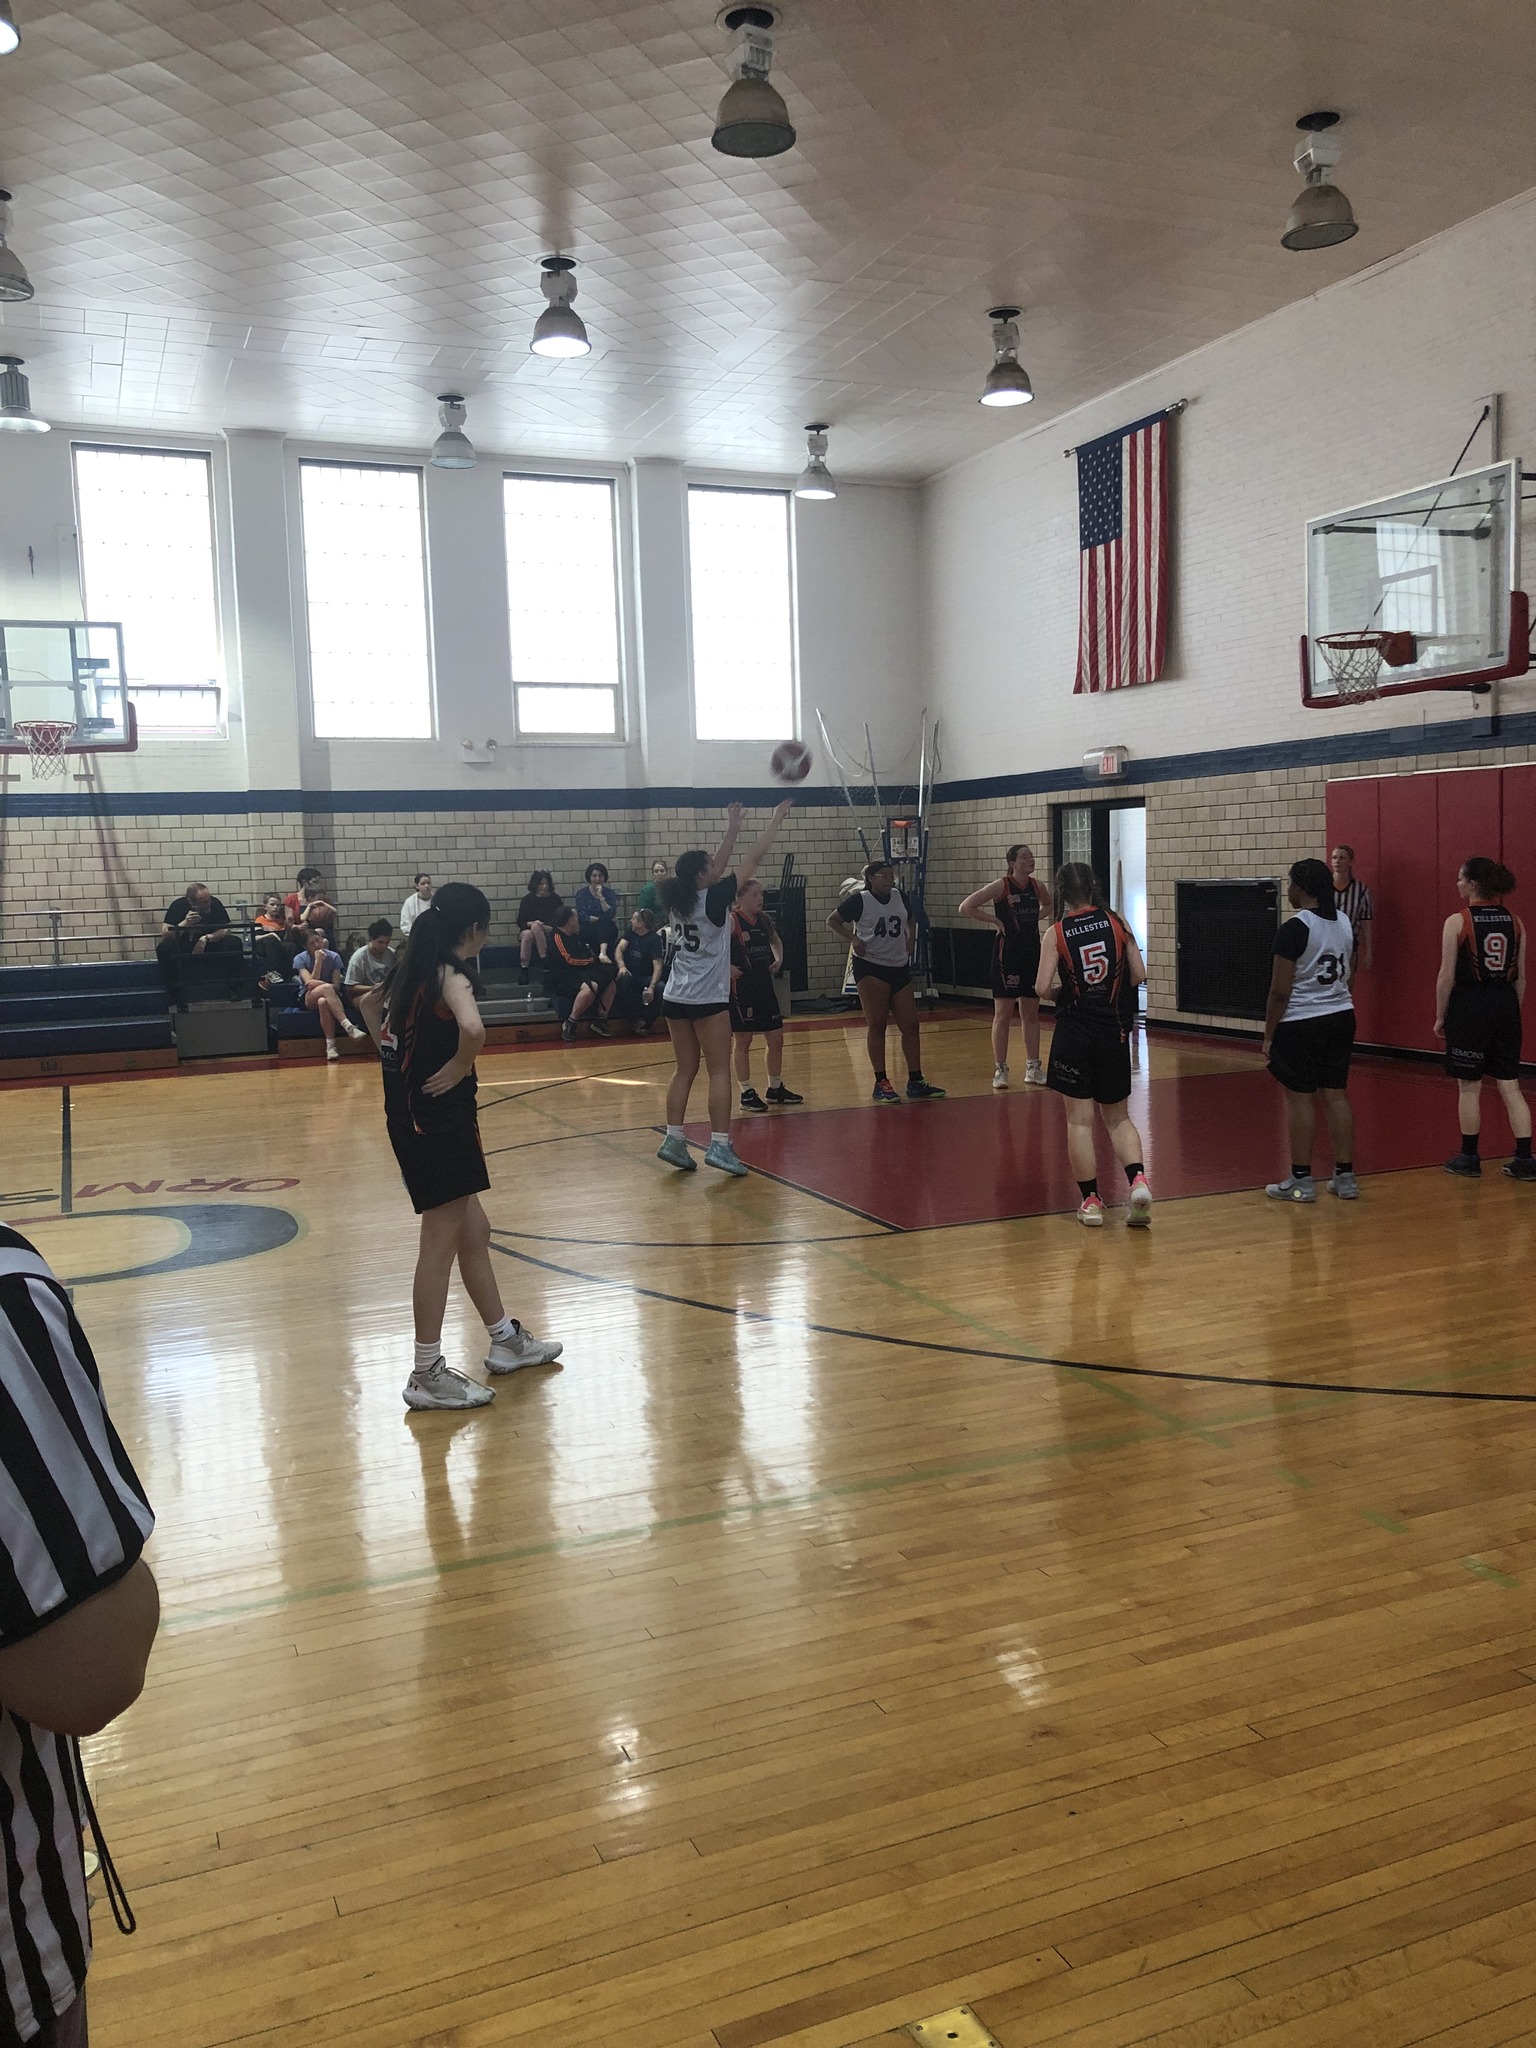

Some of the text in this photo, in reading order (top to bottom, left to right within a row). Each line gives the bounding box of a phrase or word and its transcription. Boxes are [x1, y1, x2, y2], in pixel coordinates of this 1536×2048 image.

[874, 916, 902, 938] 43
[1064, 920, 1110, 938] KILLESTER
[1473, 915, 1513, 923] KILLESTER
[671, 923, 701, 953] 25
[1079, 941, 1109, 987] 5
[1483, 932, 1508, 972] 9
